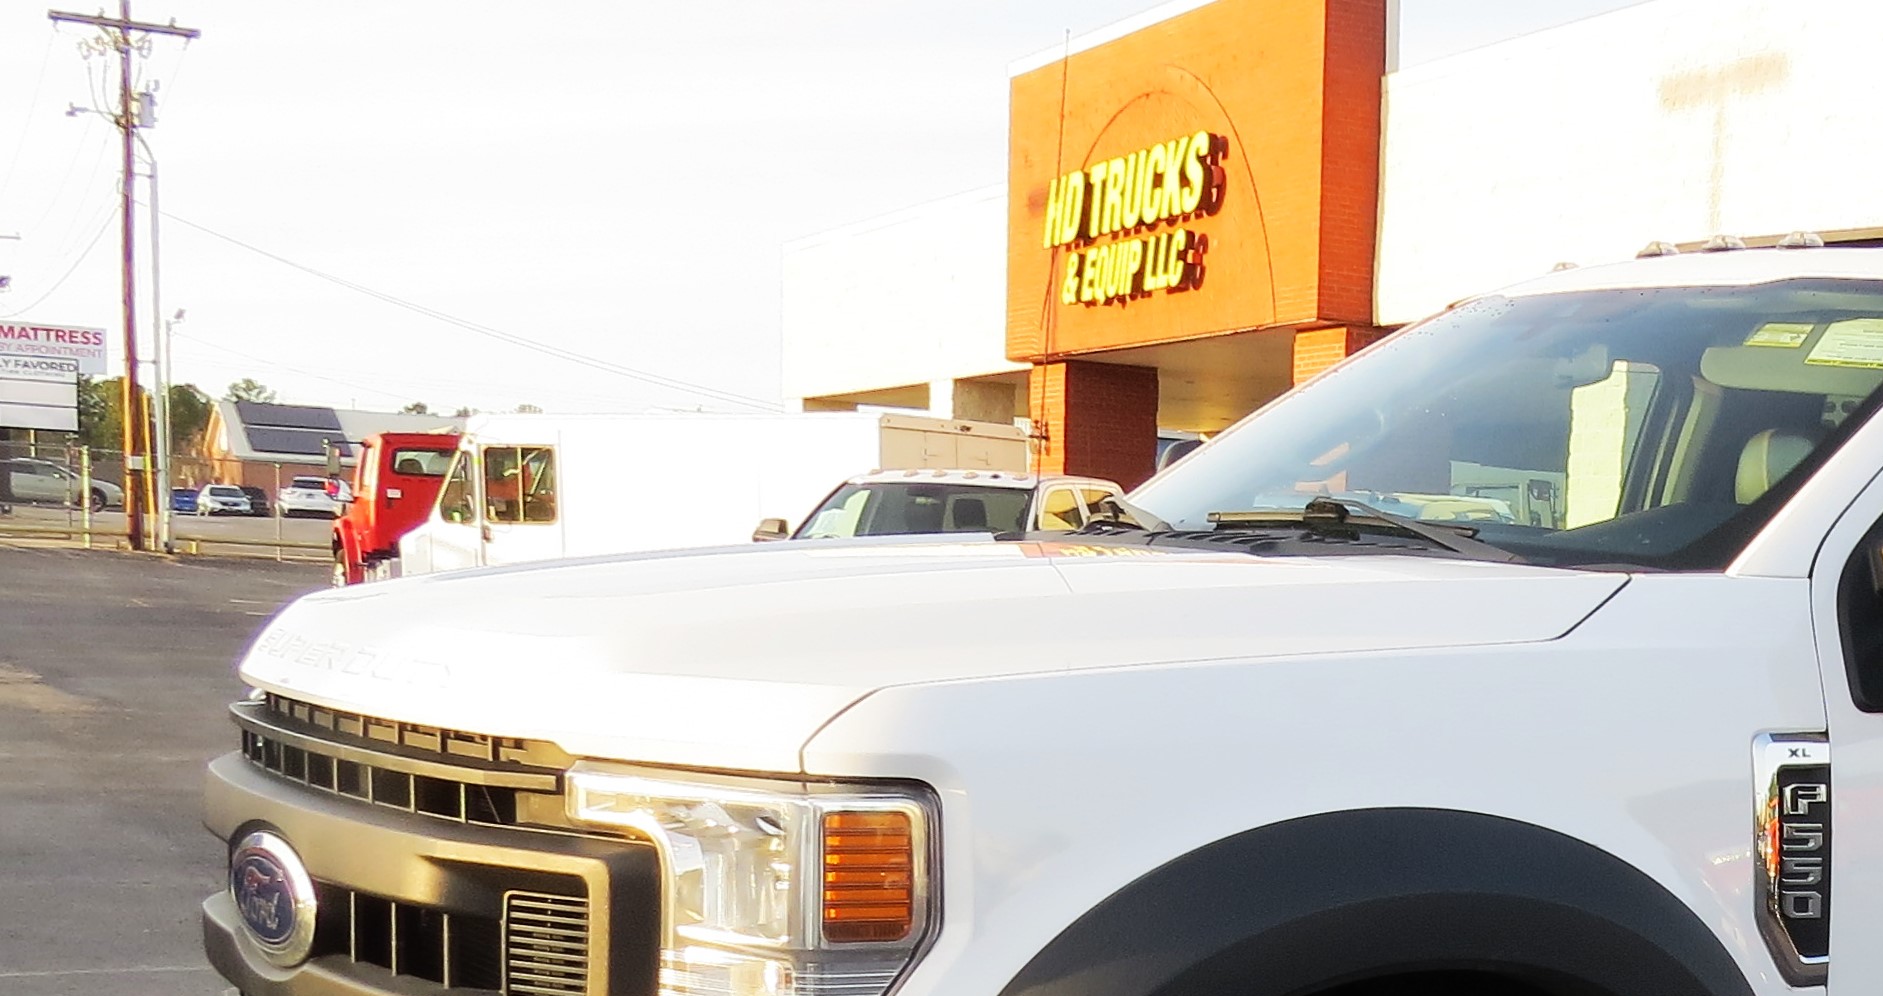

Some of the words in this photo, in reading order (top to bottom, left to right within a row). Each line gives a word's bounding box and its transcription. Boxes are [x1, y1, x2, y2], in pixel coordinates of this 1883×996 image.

[1043, 169, 1085, 249] HD
[1089, 130, 1210, 238] TRUCKS
[1061, 251, 1080, 305] &
[1081, 238, 1142, 305] EQUIP
[1143, 227, 1187, 291] LLC
[0, 325, 103, 346] MATTRESS
[16, 344, 102, 358] APPOINTMENT
[14, 360, 77, 372] FAVORED
[1788, 748, 1811, 758] XL
[1782, 783, 1827, 919] F550
